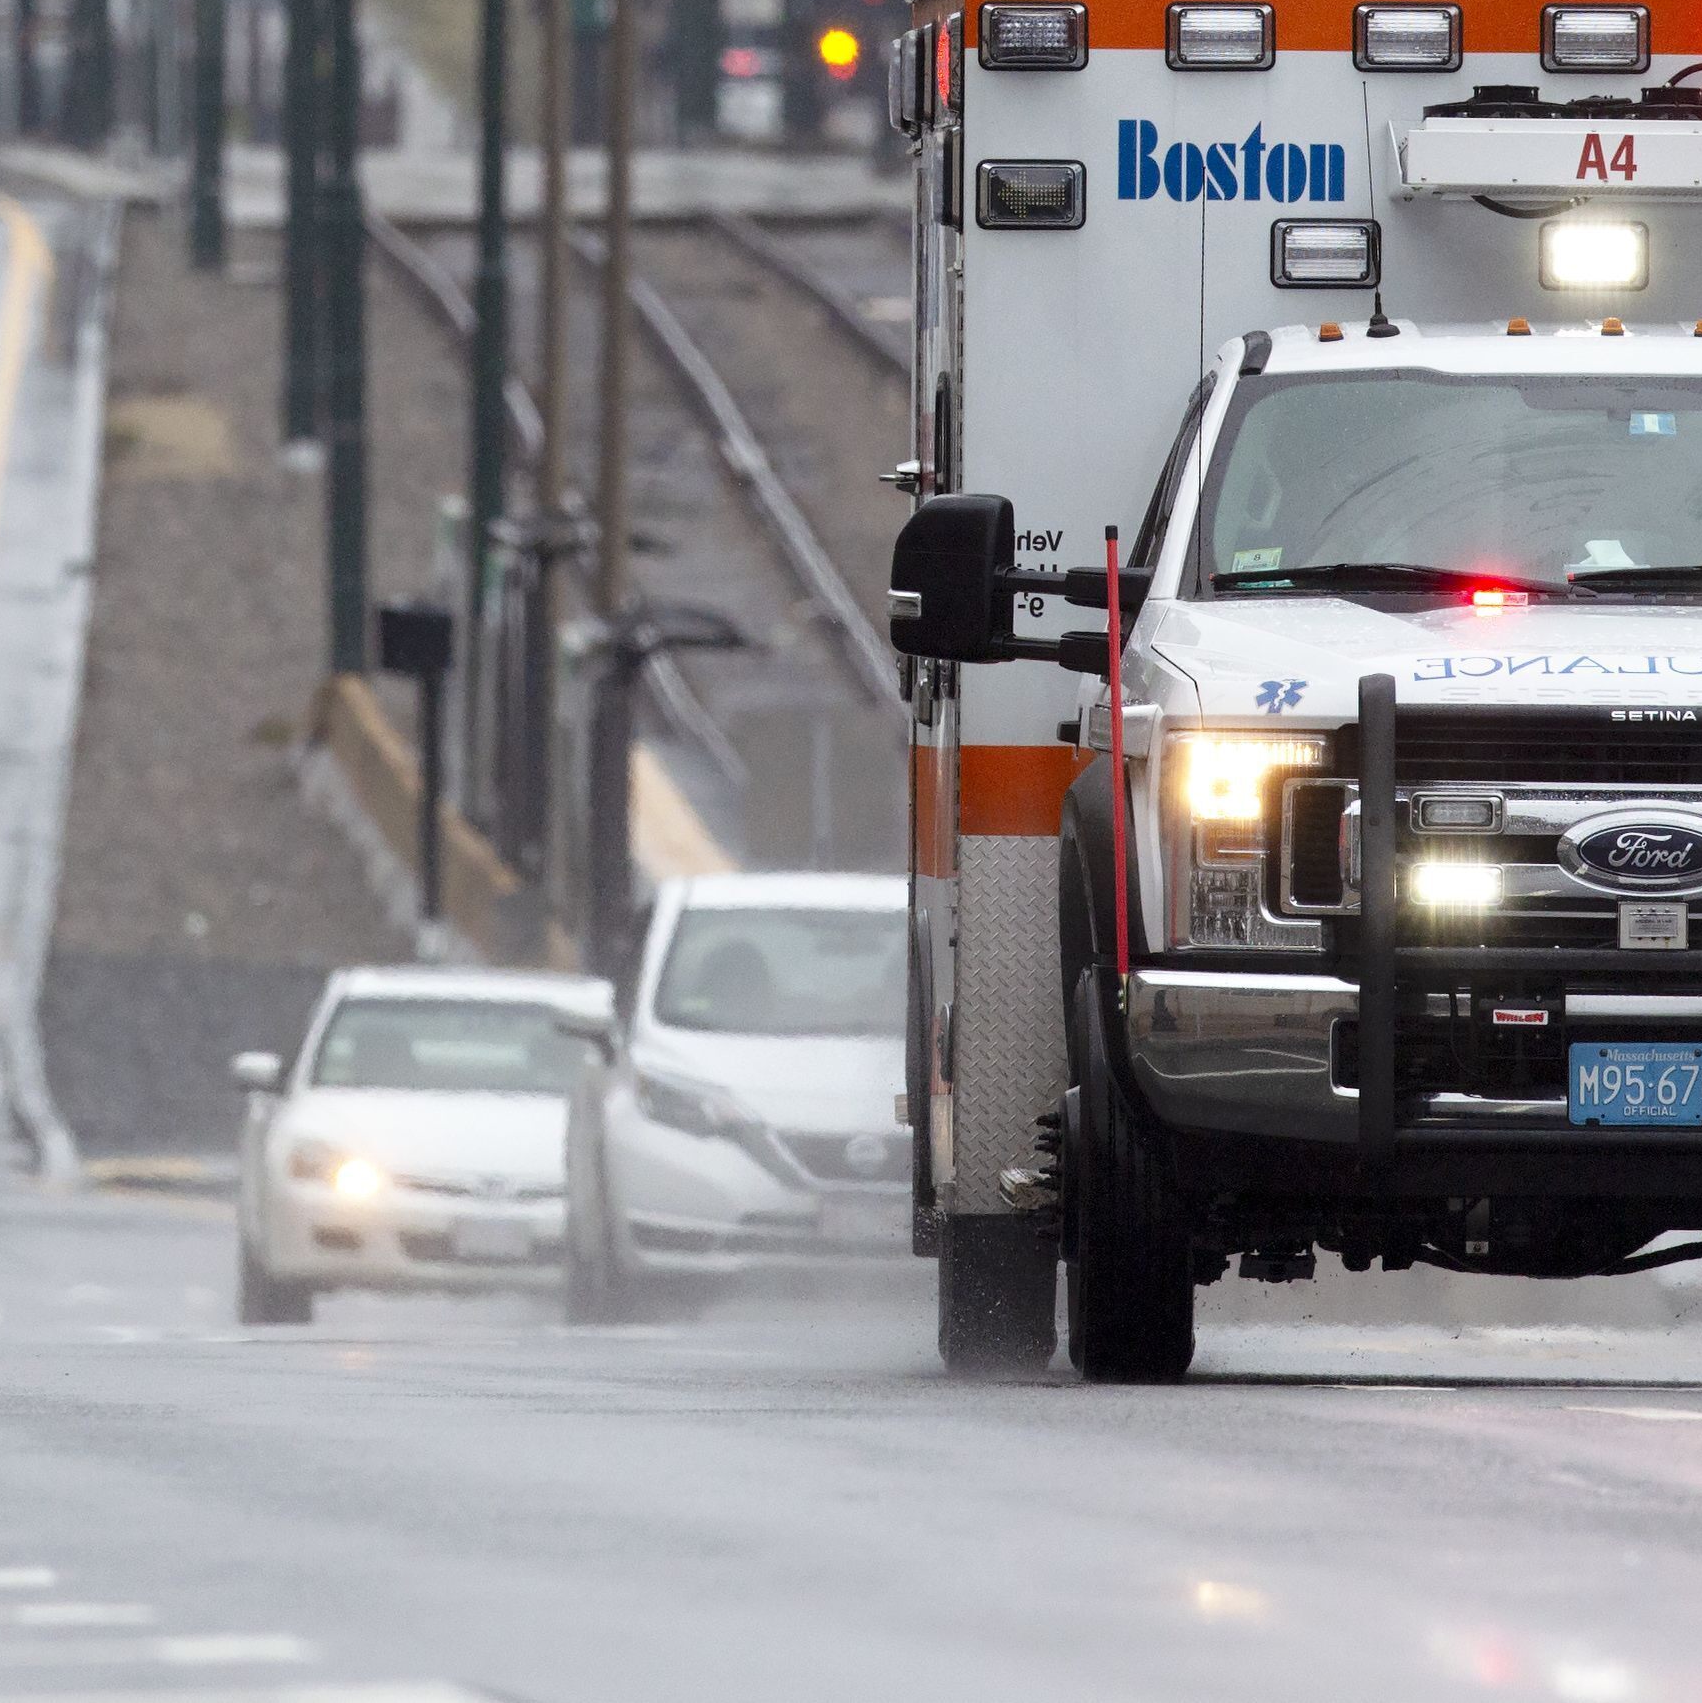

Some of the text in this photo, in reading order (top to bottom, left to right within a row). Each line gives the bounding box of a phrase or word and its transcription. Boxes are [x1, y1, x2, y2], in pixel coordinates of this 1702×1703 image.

[1118, 120, 1345, 203] Boston
[1576, 133, 1637, 181] A4
[1611, 710, 1697, 722] SETINA
[1608, 832, 1693, 868] Ford
[1606, 1048, 1695, 1062] Massachusetts
[1623, 1106, 1677, 1117] OFFICIAL
